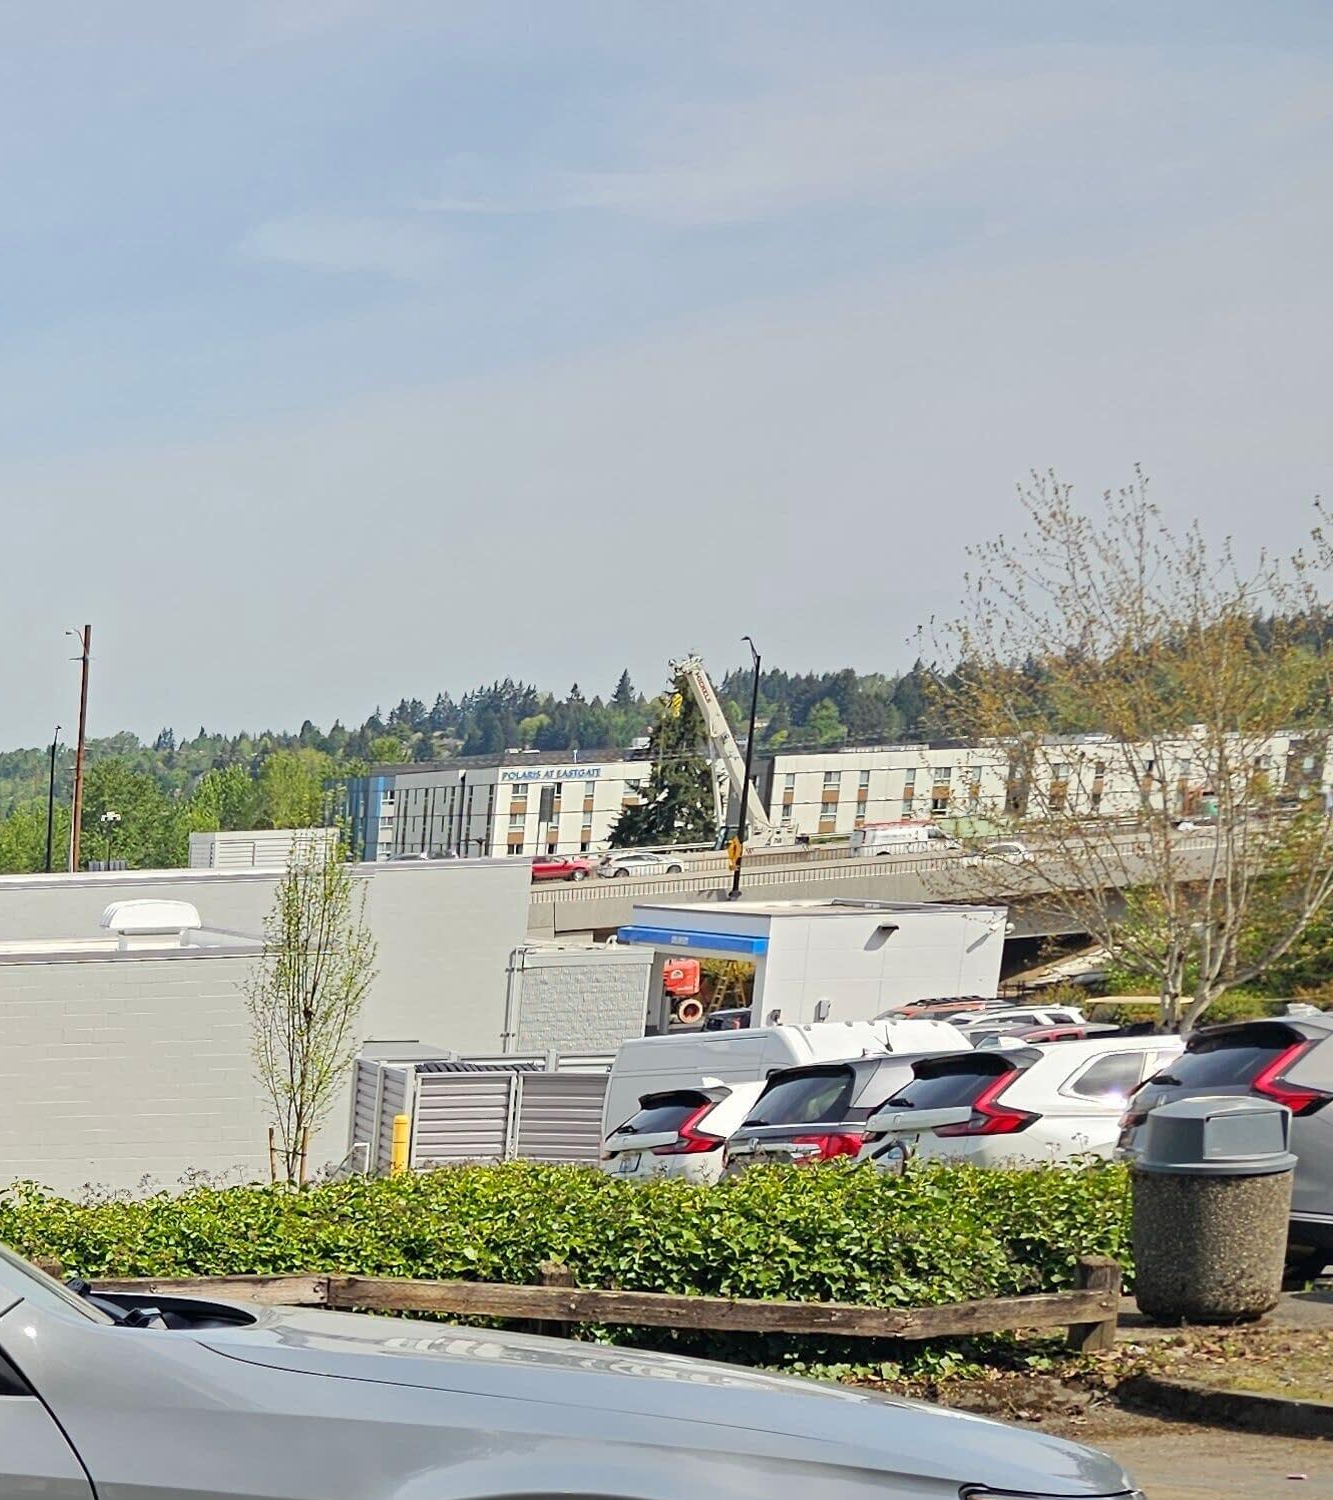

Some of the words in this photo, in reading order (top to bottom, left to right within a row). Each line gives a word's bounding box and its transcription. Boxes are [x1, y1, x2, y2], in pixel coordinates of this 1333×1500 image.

[501, 770, 541, 781] POLARIS
[544, 770, 554, 778] AT
[556, 768, 601, 779] EASTGATE
